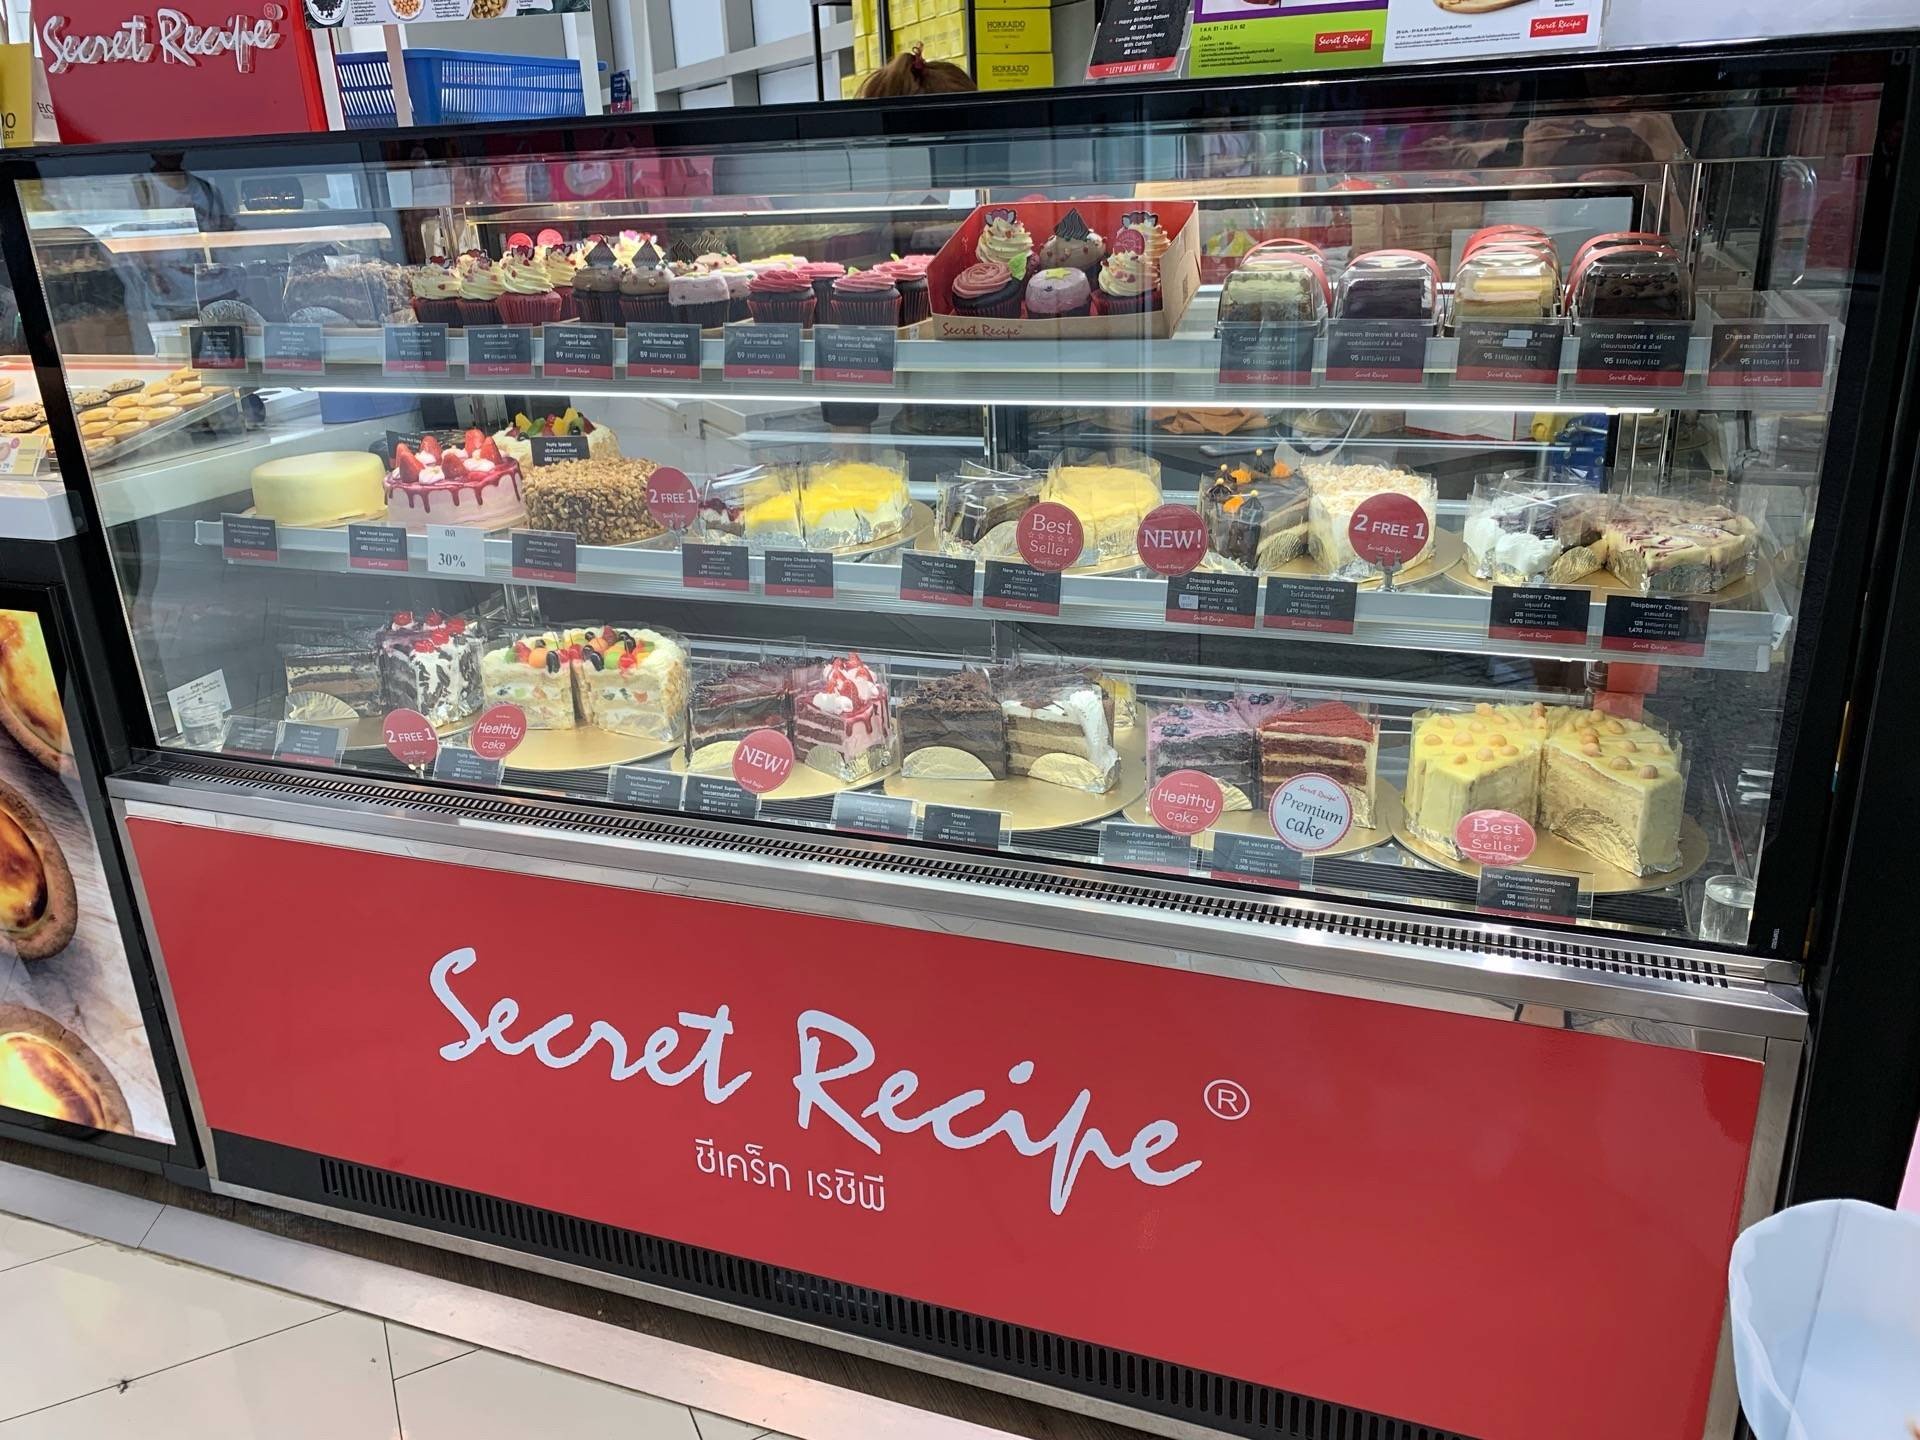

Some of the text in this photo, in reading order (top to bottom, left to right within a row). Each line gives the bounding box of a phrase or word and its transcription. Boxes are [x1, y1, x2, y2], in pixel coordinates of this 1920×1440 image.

[987, 20, 1025, 29] HOKKAIDO
[1534, 19, 1581, 32] Secret Recipe
[43, 9, 279, 73] Secret Recipe
[1318, 34, 1367, 47] Secret Recipe
[992, 65, 1029, 73] HOKKAIDO
[942, 322, 1020, 339] Secret Recipe
[1740, 357, 1751, 365] 95
[649, 489, 696, 504] 2 FREE 1
[1032, 513, 1073, 535] Best
[1353, 514, 1426, 540] 2 FREE 1
[1143, 528, 1202, 549] NEW!
[1030, 539, 1070, 557] Seller
[438, 552, 466, 568] 30%
[1189, 577, 1215, 585] Chocolate
[1512, 592, 1542, 601] Blueberry
[1630, 601, 1662, 610] Raspberry
[386, 727, 435, 744] 2 FREE 1
[478, 722, 521, 740] Healthy
[481, 739, 506, 751] cake
[738, 745, 790, 776] NEW!
[1157, 788, 1216, 814] Healthy
[1281, 791, 1344, 825] Premium
[1166, 810, 1200, 824] cake
[1285, 815, 1325, 841] cake
[1472, 818, 1521, 836] Best
[1471, 838, 1520, 853] Seller
[1486, 872, 1533, 883] White Chocolate
[429, 946, 1203, 1216] Secret Recipe
[695, 1138, 886, 1212] ซีเคร็ท เรซิพี
